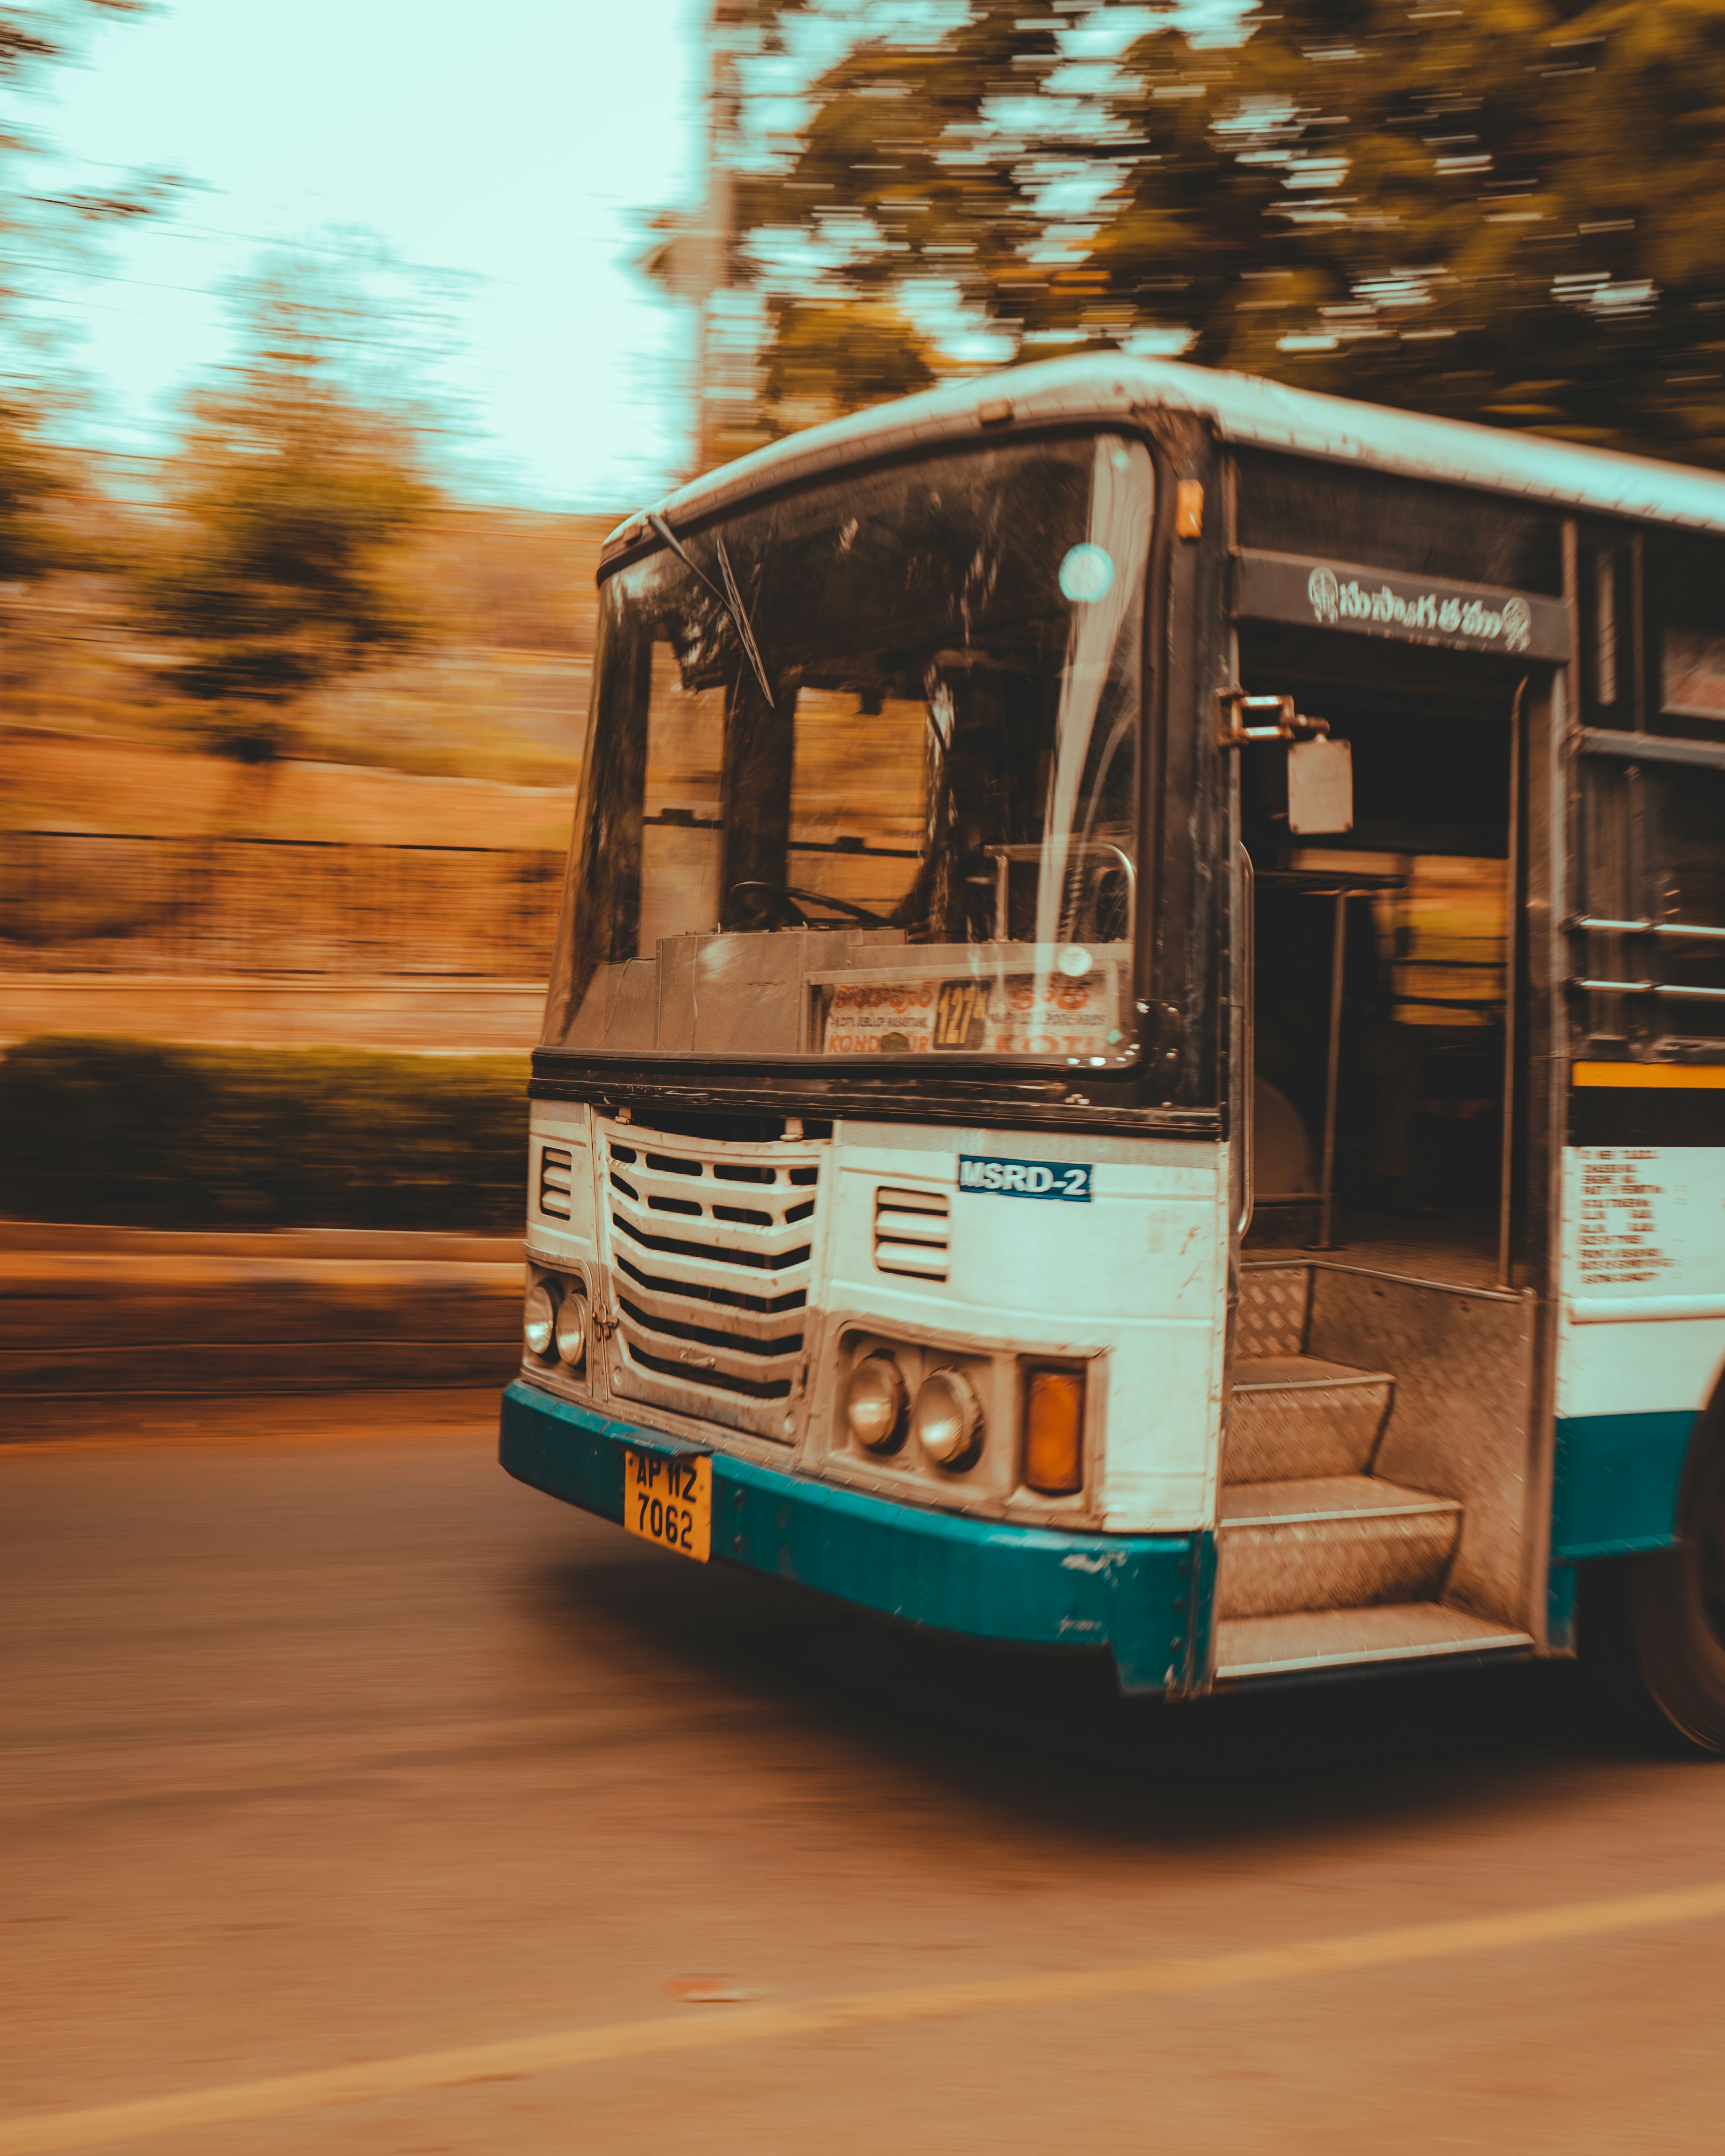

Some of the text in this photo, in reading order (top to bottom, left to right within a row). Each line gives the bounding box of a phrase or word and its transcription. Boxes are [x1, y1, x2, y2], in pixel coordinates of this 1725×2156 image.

[828, 1034, 929, 1053] KONDUR
[995, 1035, 1094, 1054] KOTI
[960, 1160, 1087, 1195] MSRD-2
[636, 1454, 661, 1488] AP
[638, 1492, 692, 1550] 7062
